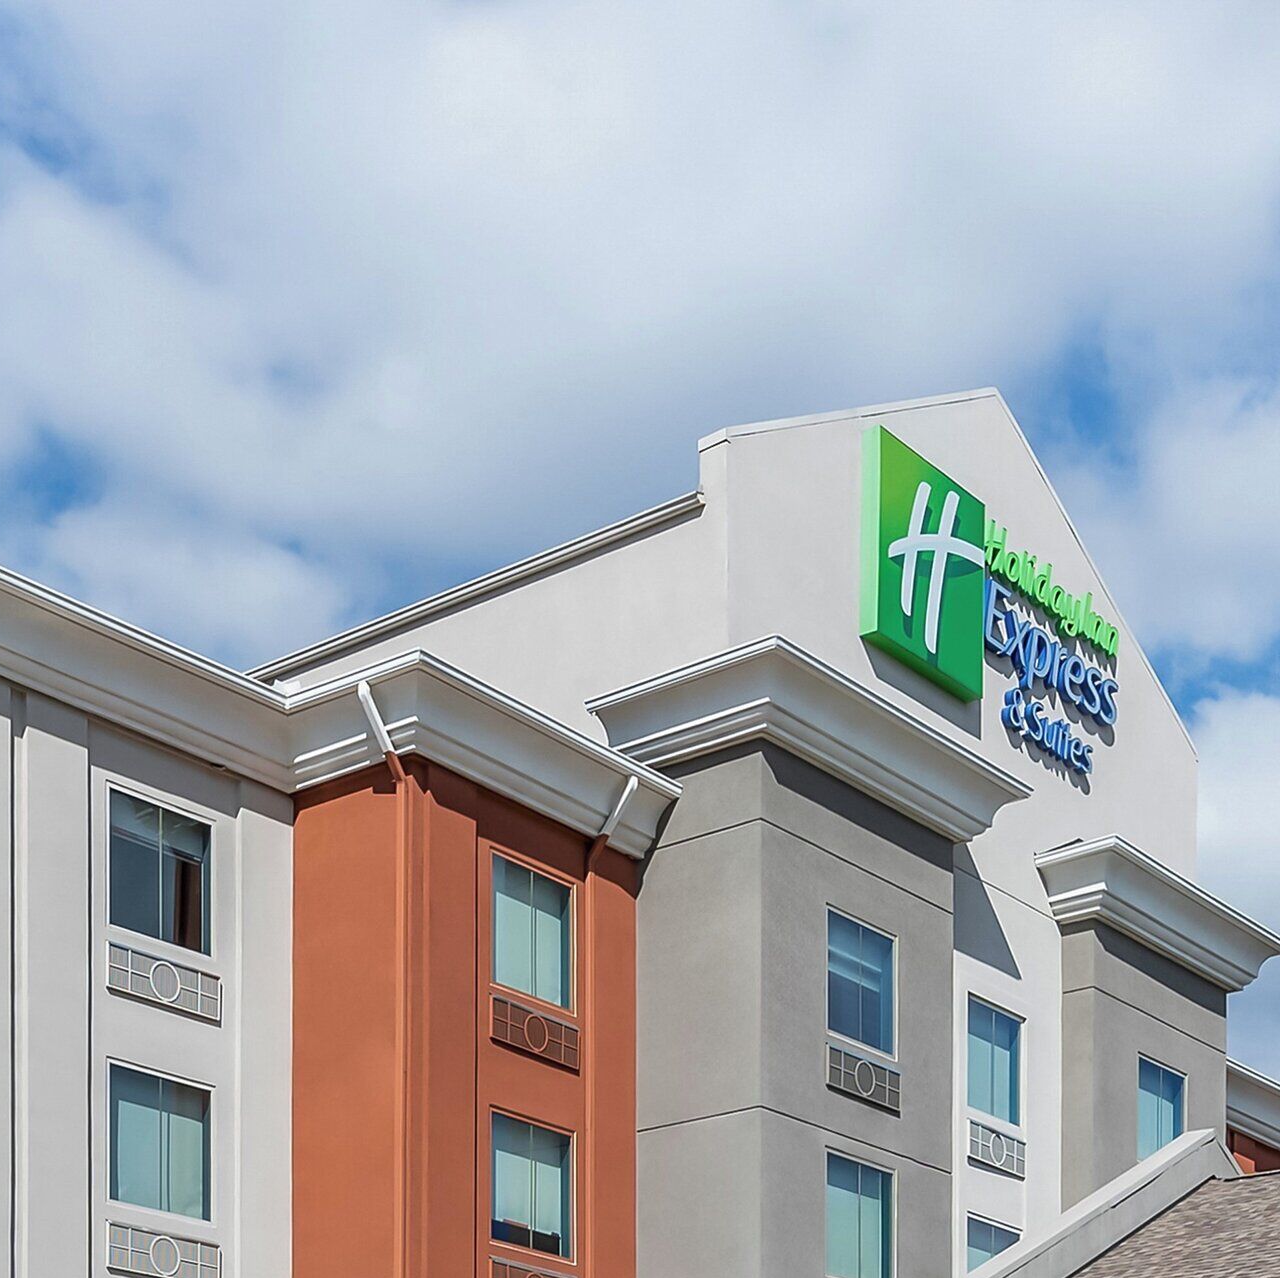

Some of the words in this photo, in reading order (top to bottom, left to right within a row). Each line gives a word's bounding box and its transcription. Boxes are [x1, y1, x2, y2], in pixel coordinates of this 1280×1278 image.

[984, 519, 1081, 637] Holiday
[1079, 591, 1119, 657] Inn
[984, 577, 1119, 726] Express
[1001, 687, 1024, 733] &
[1023, 701, 1094, 775] Suites
